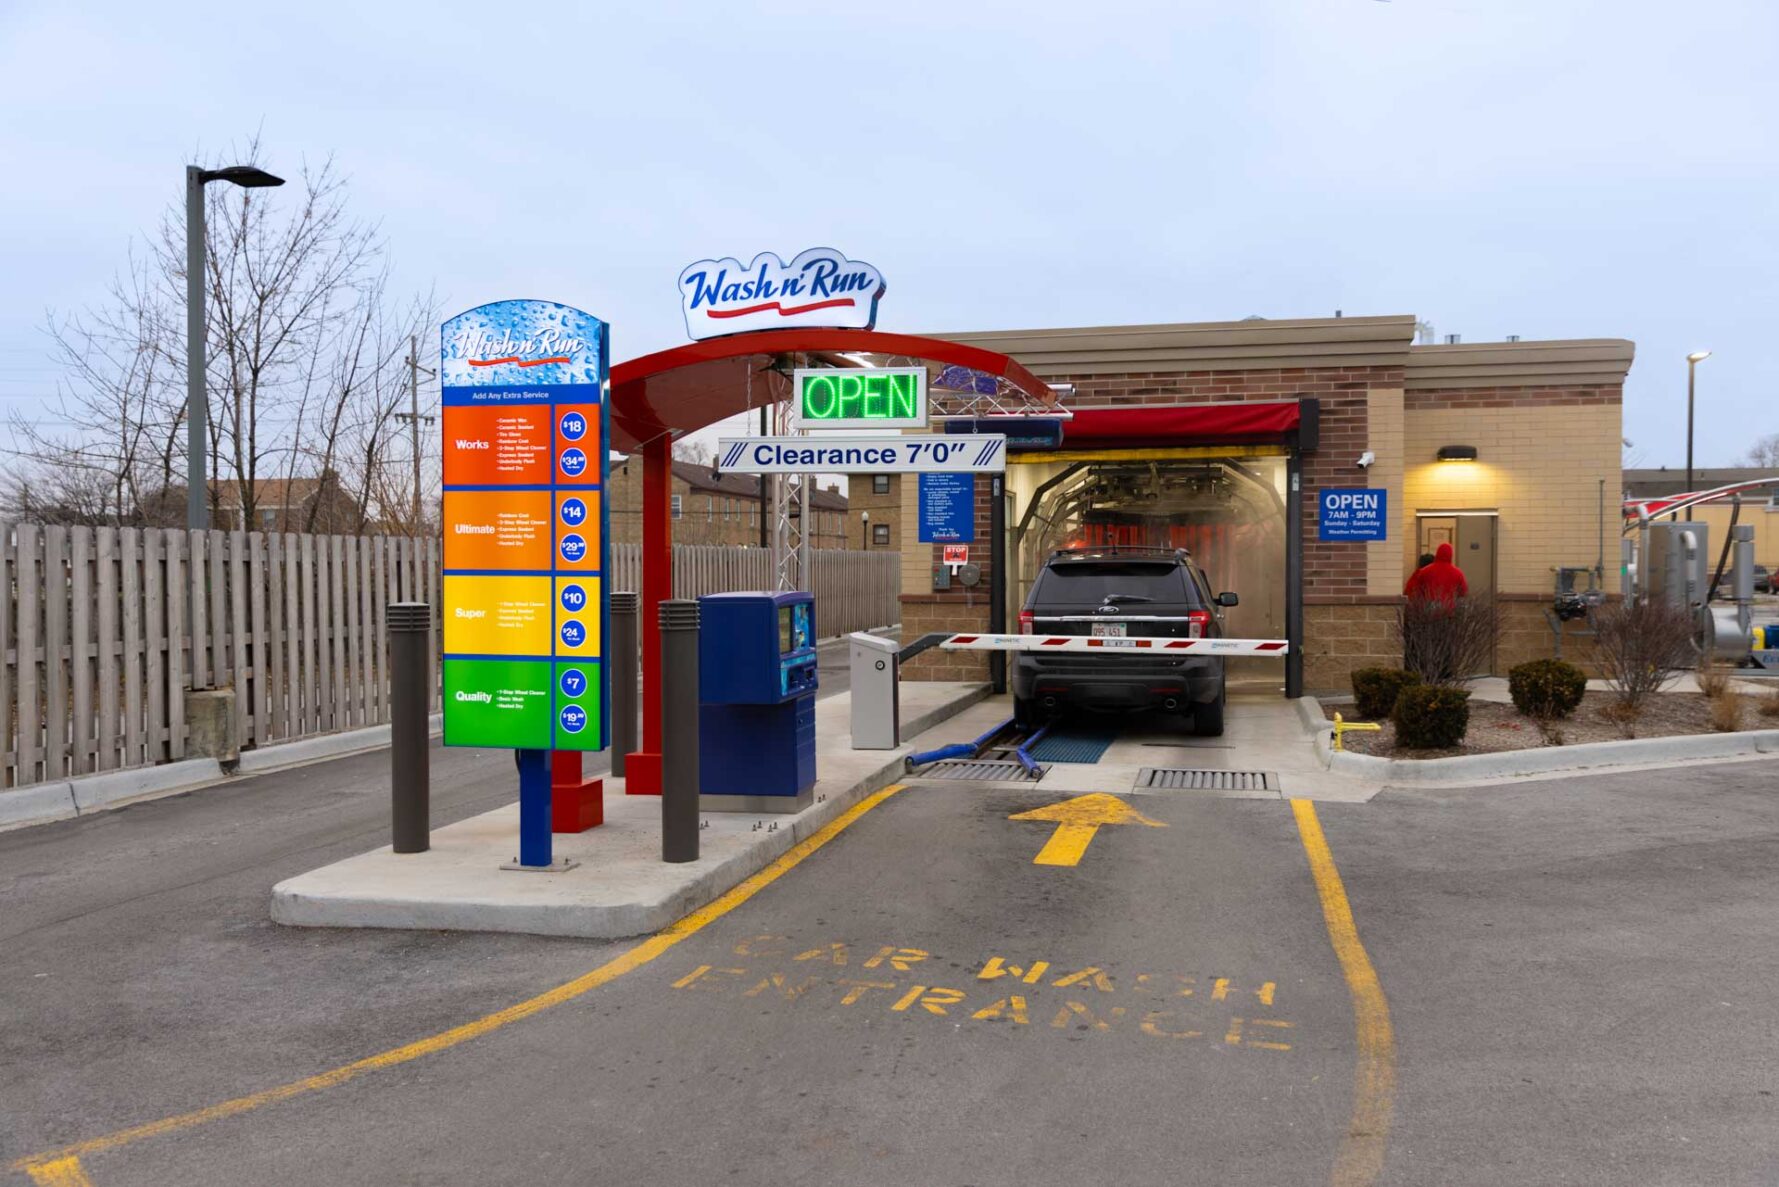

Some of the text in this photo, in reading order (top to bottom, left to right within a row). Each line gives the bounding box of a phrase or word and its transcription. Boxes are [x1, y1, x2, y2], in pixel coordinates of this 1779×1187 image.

[685, 263, 779, 310] Wash
[801, 258, 874, 298] Run
[454, 328, 519, 359] Wash
[536, 328, 584, 356] Run
[472, 392, 487, 400] Add
[488, 392, 501, 401] Any
[523, 391, 549, 399] Service
[806, 374, 914, 419] OPEN
[563, 421, 581, 432] $18
[455, 440, 489, 450] Works
[753, 443, 965, 465] Clearance 7'0"
[1325, 494, 1378, 509] OPEN
[563, 507, 582, 518] $14
[1328, 511, 1348, 519] 7AM
[1356, 511, 1376, 519] 9PM
[455, 524, 495, 534] Ultimate
[564, 592, 582, 604] $10
[455, 608, 486, 619] Super
[567, 677, 579, 689] $7
[456, 691, 492, 703] Quality
[732, 935, 1276, 1005] CAR WASH
[670, 965, 1295, 1050] ENTRANCE
